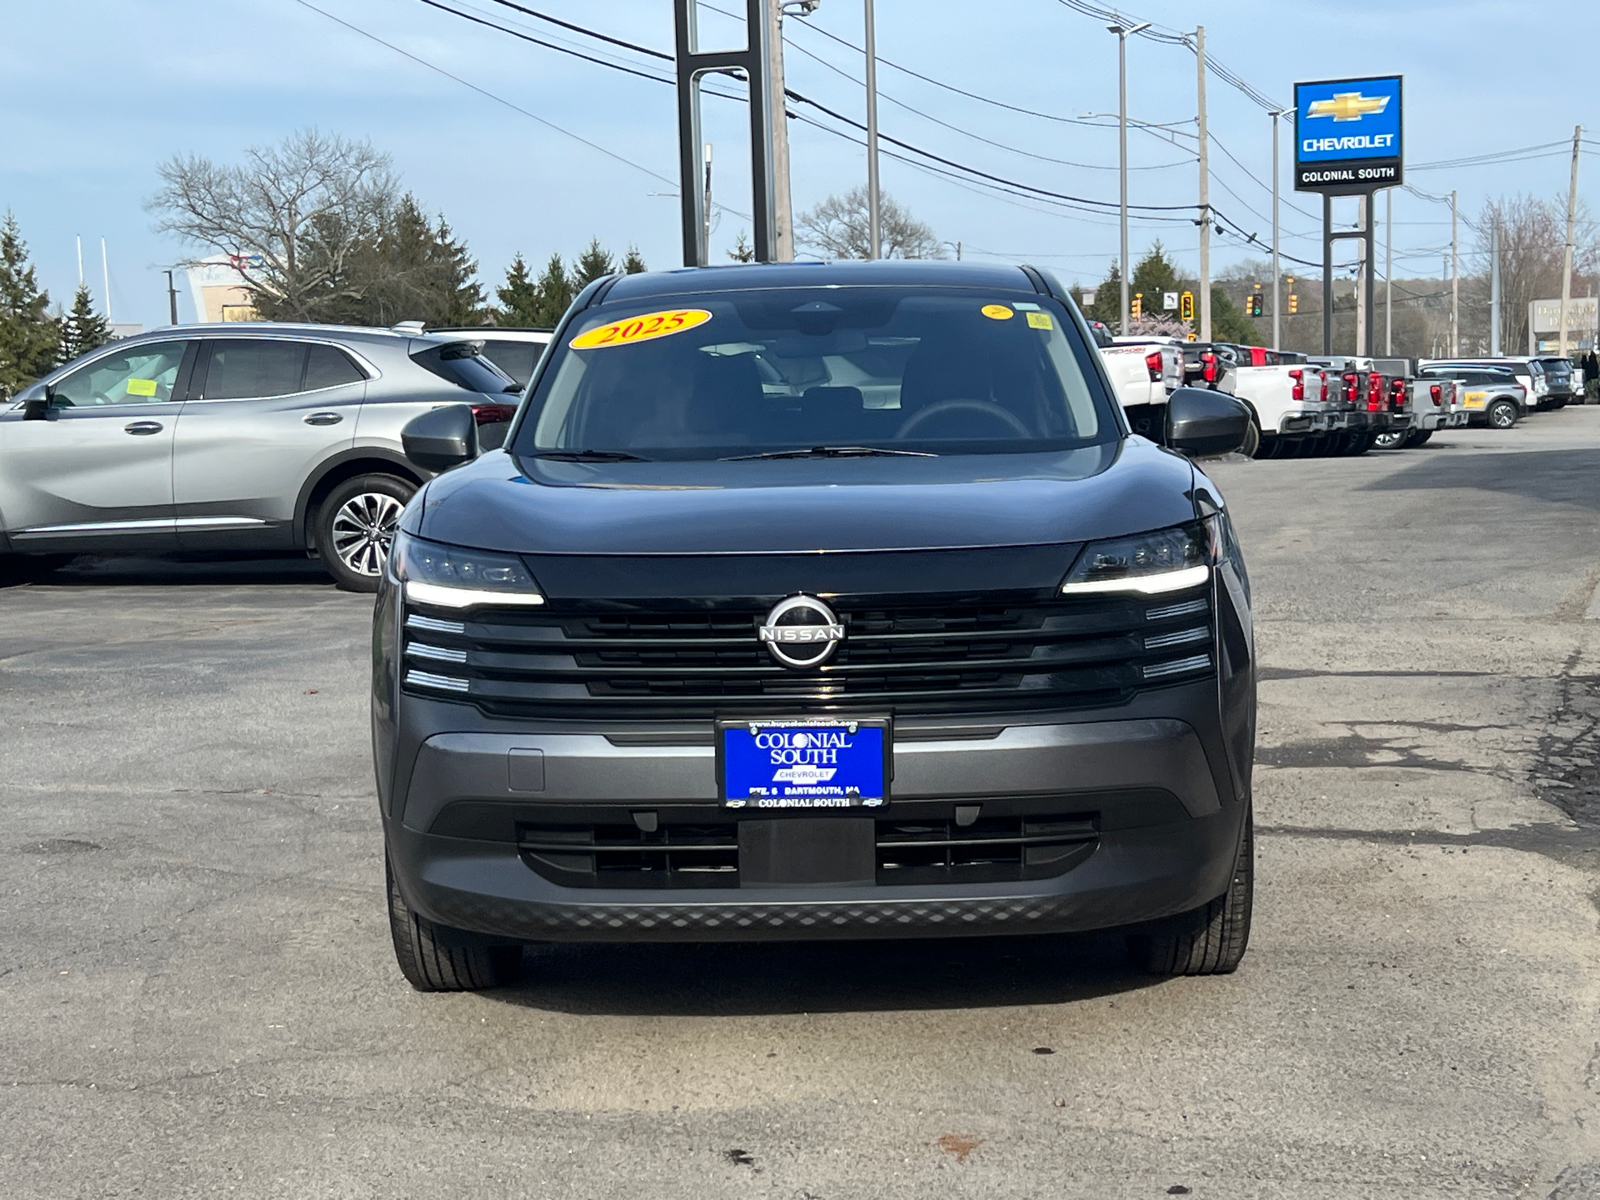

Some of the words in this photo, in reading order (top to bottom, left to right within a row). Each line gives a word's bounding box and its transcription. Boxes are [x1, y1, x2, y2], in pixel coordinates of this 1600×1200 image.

[1303, 134, 1394, 151] CHEVROLET
[1302, 170, 1355, 182] COLONIAL
[1358, 167, 1394, 179] SOUTH
[596, 312, 689, 345] 2025
[761, 627, 843, 641] NISSAN
[755, 732, 852, 749] COLONIAL
[771, 749, 837, 764] SOUTH
[779, 770, 830, 778] CHEVROLET
[758, 798, 812, 808] COLONIAL
[813, 798, 850, 807] SOUTH
